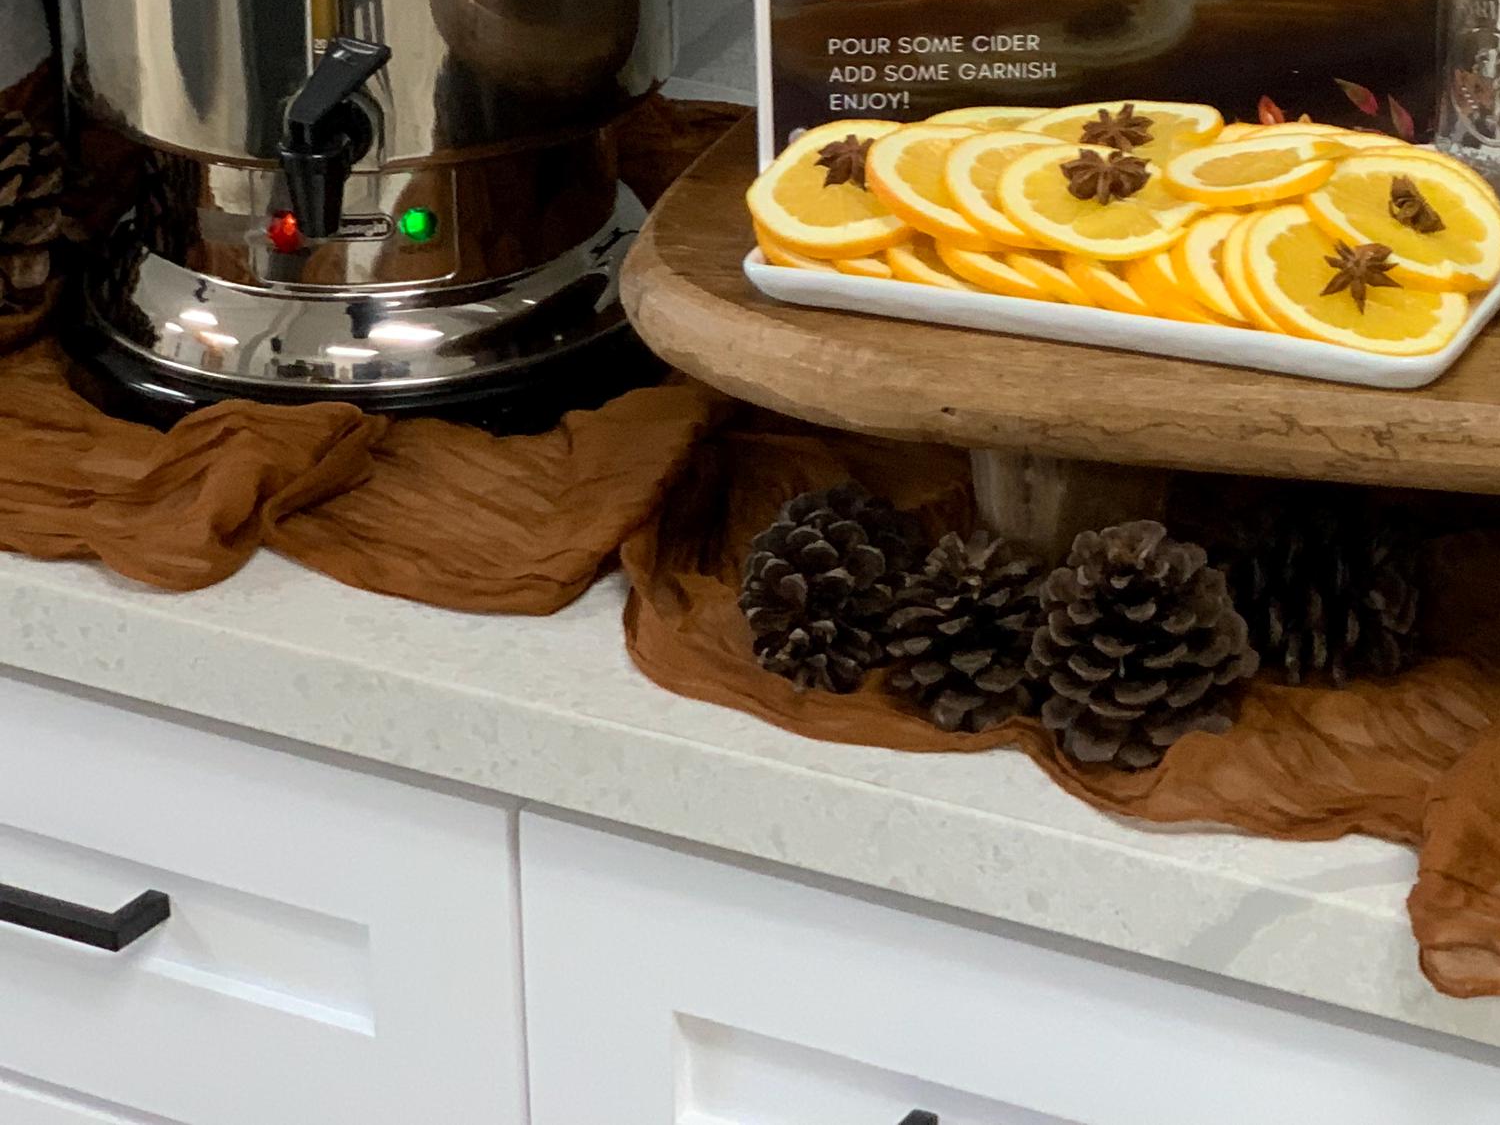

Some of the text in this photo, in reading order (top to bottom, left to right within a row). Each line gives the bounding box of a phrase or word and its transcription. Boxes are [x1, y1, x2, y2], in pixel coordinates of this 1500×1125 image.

[828, 34, 1041, 55] POUR SOME CIDER
[828, 61, 1057, 83] ADD SOME GARNISH
[829, 91, 910, 111] ENJOY!
